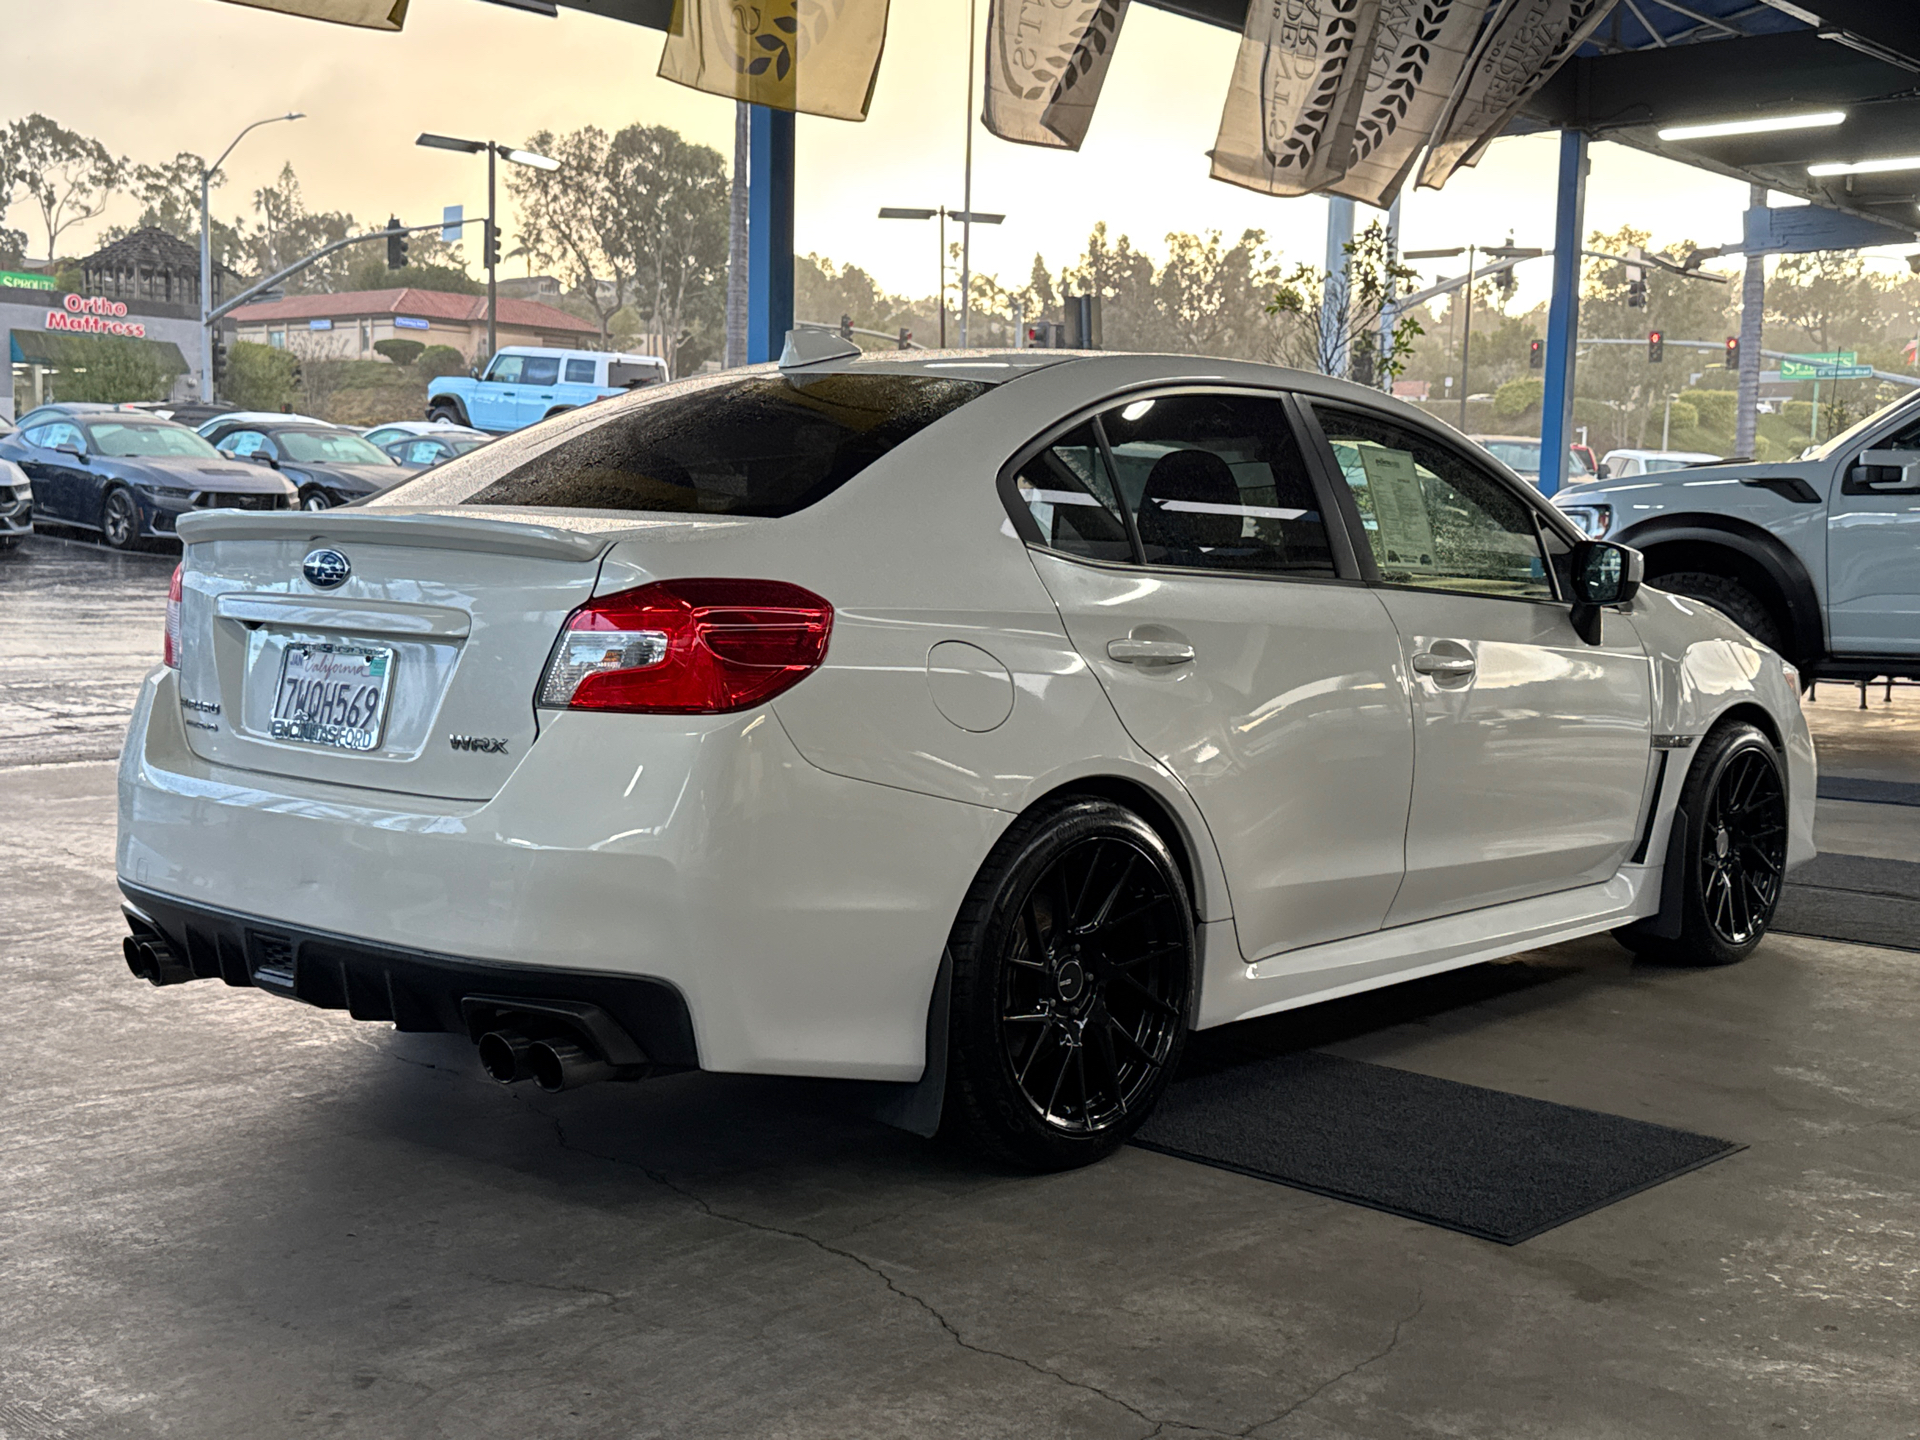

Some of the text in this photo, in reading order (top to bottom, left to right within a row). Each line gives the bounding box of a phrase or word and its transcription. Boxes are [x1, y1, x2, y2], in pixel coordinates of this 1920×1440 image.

[64, 293, 127, 317] Ortho
[46, 310, 145, 338] Mattress
[304, 652, 371, 681] California
[283, 677, 380, 730] 7WQH569
[337, 727, 372, 749] FORD
[449, 733, 509, 755] WRX
